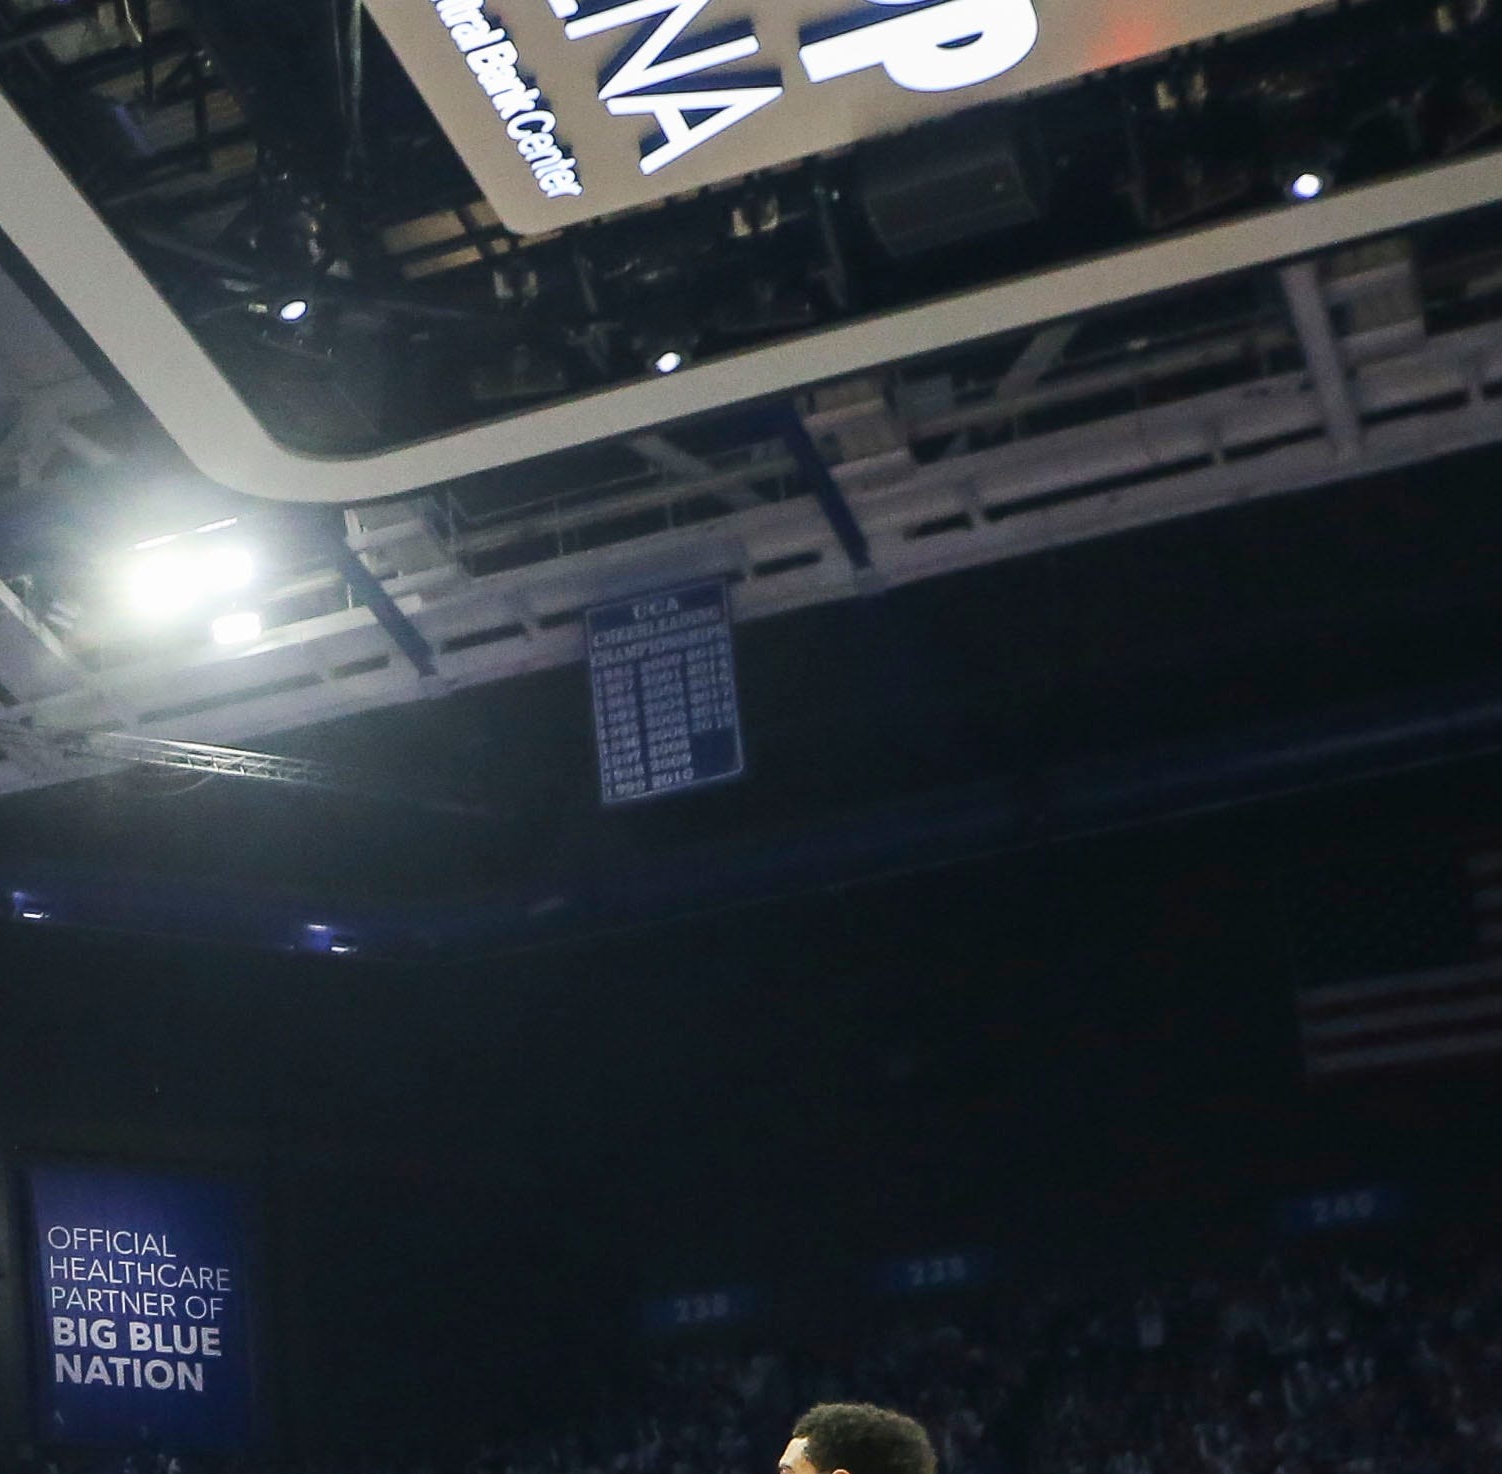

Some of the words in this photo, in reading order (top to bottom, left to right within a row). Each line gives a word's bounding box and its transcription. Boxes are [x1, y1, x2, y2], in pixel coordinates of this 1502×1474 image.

[466, 40, 541, 120] Bank
[507, 110, 583, 198] Center
[47, 1226, 177, 1258] OFFICIAL
[50, 1256, 231, 1292] HEALTHCARE
[51, 1286, 176, 1317] PARTNER
[185, 1296, 224, 1320] OF
[53, 1317, 118, 1350] BIG
[129, 1321, 222, 1356] BLUE
[55, 1353, 203, 1391] NATION
